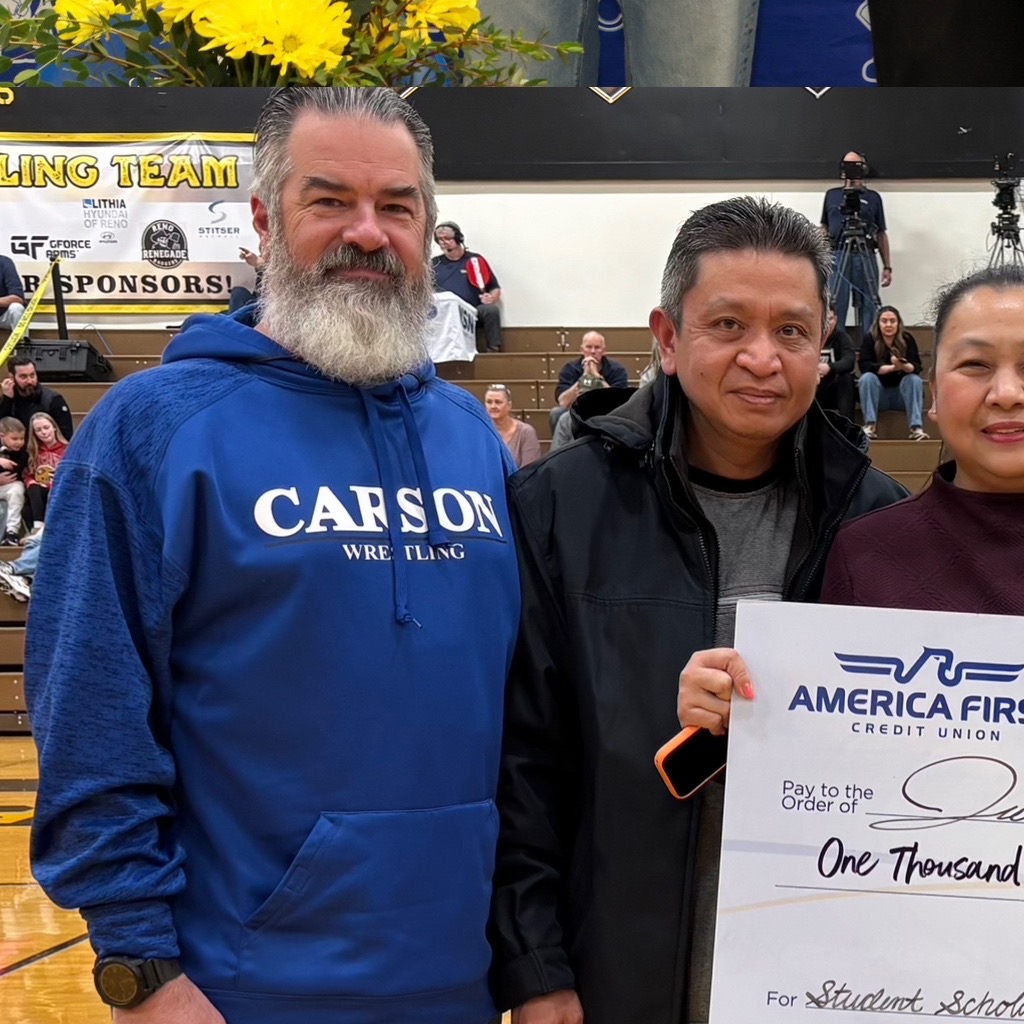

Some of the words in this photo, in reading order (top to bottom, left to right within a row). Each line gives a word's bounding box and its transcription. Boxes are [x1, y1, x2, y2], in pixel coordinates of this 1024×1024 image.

[112, 154, 239, 189] TEAM
[92, 199, 126, 209] LITHIA
[83, 209, 128, 219] HYUNDAI
[84, 219, 100, 228] OF
[101, 219, 128, 228] RENO
[152, 222, 174, 232] RENO
[50, 239, 91, 249] GFORCE
[143, 249, 187, 259] RENEGADE
[60, 274, 232, 294] SPONSORS!
[253, 485, 503, 537] CARSON
[342, 543, 465, 561] WRETLING
[788, 684, 953, 720] AMERICA
[851, 722, 925, 737] CREDIT
[938, 727, 1000, 741] UNION
[782, 780, 815, 799] Pay
[821, 782, 840, 798] to
[845, 784, 874, 800] the
[781, 795, 834, 813] Order
[839, 799, 859, 814] of
[817, 837, 880, 878] One
[889, 841, 1023, 887] Thousand
[766, 991, 798, 1008] For
[805, 979, 925, 1013] Student
